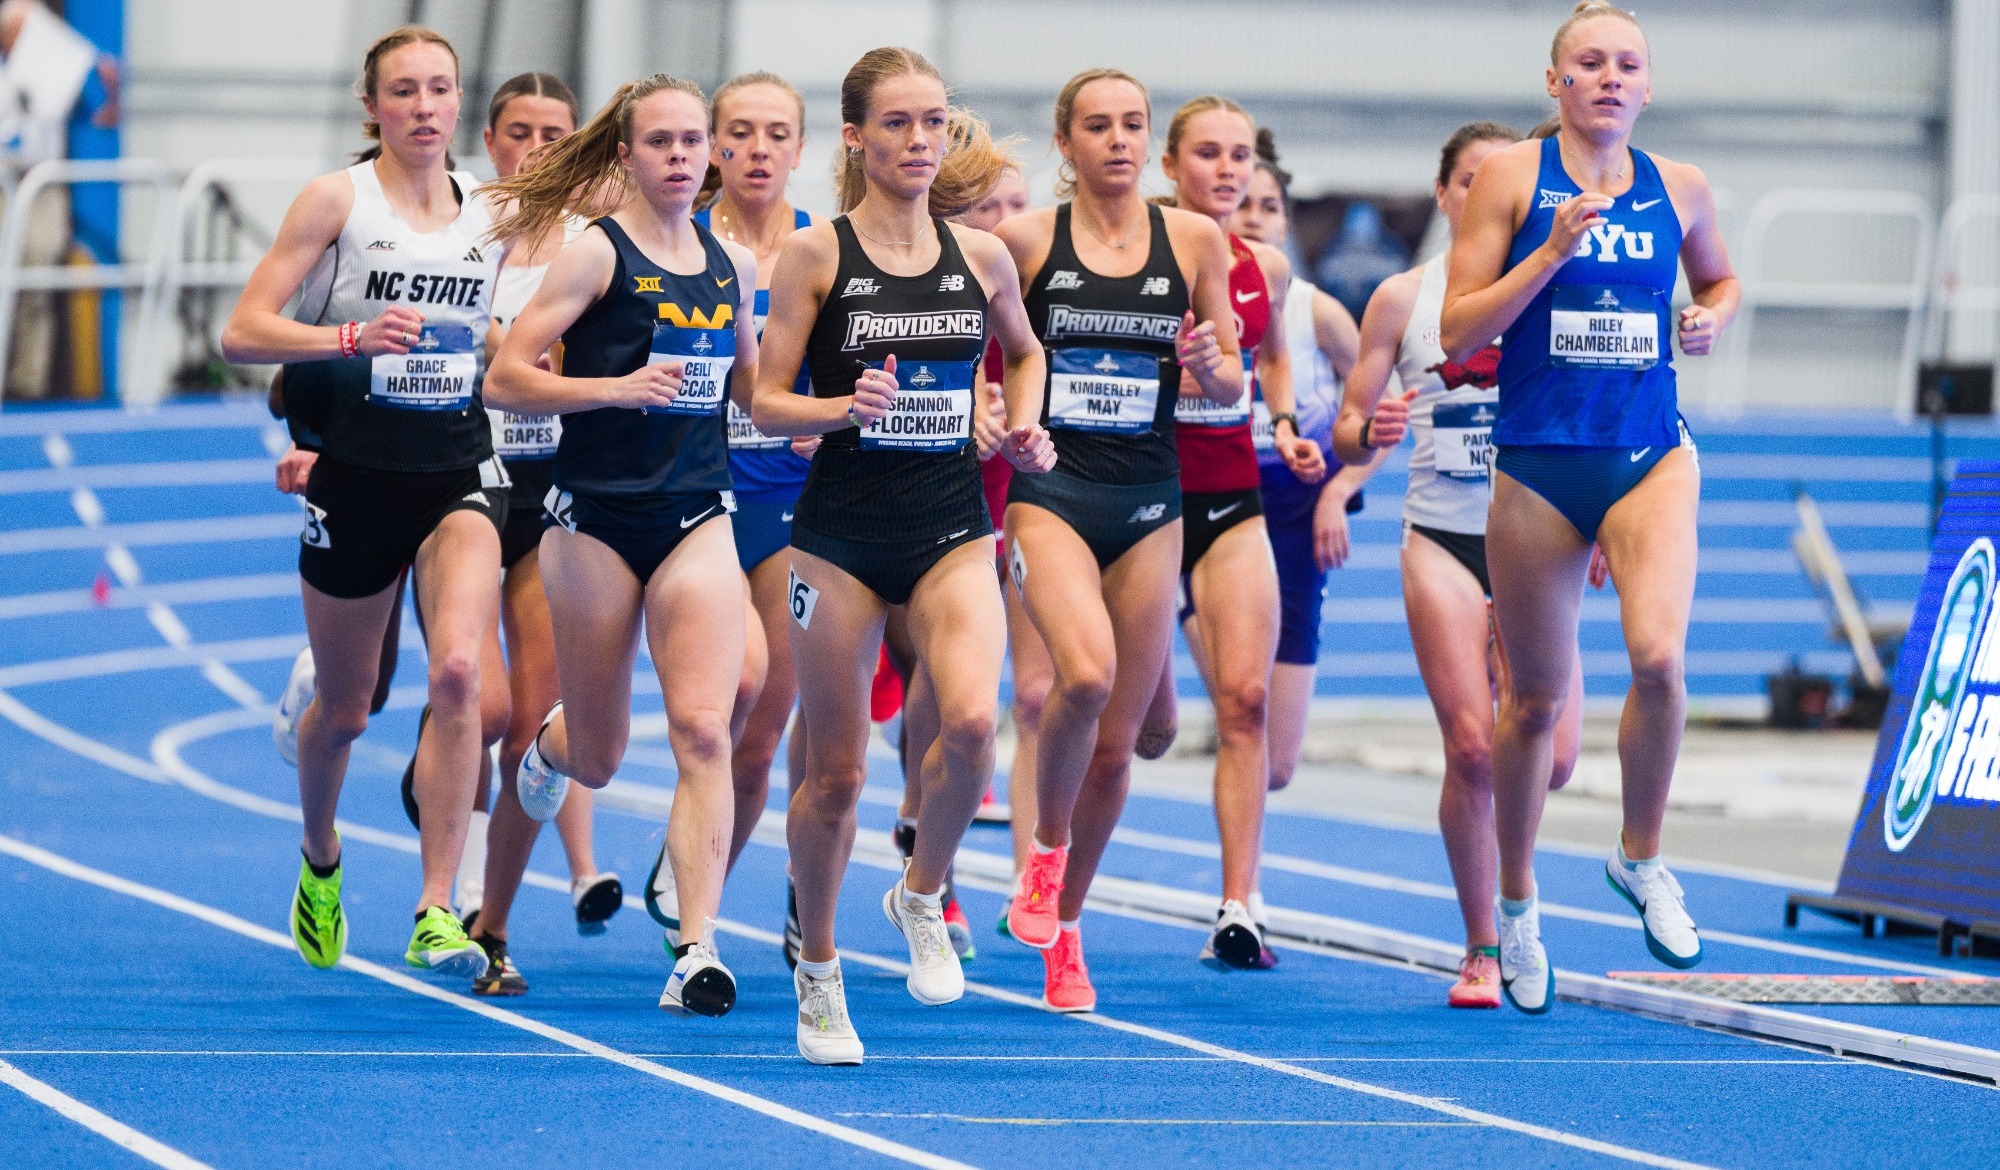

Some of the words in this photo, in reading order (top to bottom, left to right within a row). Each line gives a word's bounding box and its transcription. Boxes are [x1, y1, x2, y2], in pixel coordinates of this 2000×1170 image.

[367, 240, 396, 250] ACC
[364, 270, 405, 302] NC
[407, 273, 485, 307] STATE
[843, 285, 882, 294] EAST
[849, 277, 875, 286] BIG
[847, 313, 981, 347] PROVIDENCE
[1050, 308, 1180, 339] PROVIDENCE
[1589, 318, 1623, 332] RILEY
[1555, 334, 1653, 353] CHAMBERLAIN
[406, 359, 446, 374] GRACE
[685, 361, 712, 377] CEILI
[387, 376, 463, 393] HARTMAN
[677, 379, 718, 398] CCAB
[1069, 380, 1141, 397] KIMBERLEY
[889, 396, 953, 412] SHANNON
[1087, 398, 1121, 416] MAY
[504, 427, 553, 444] GAPES
[789, 570, 810, 620] 16
